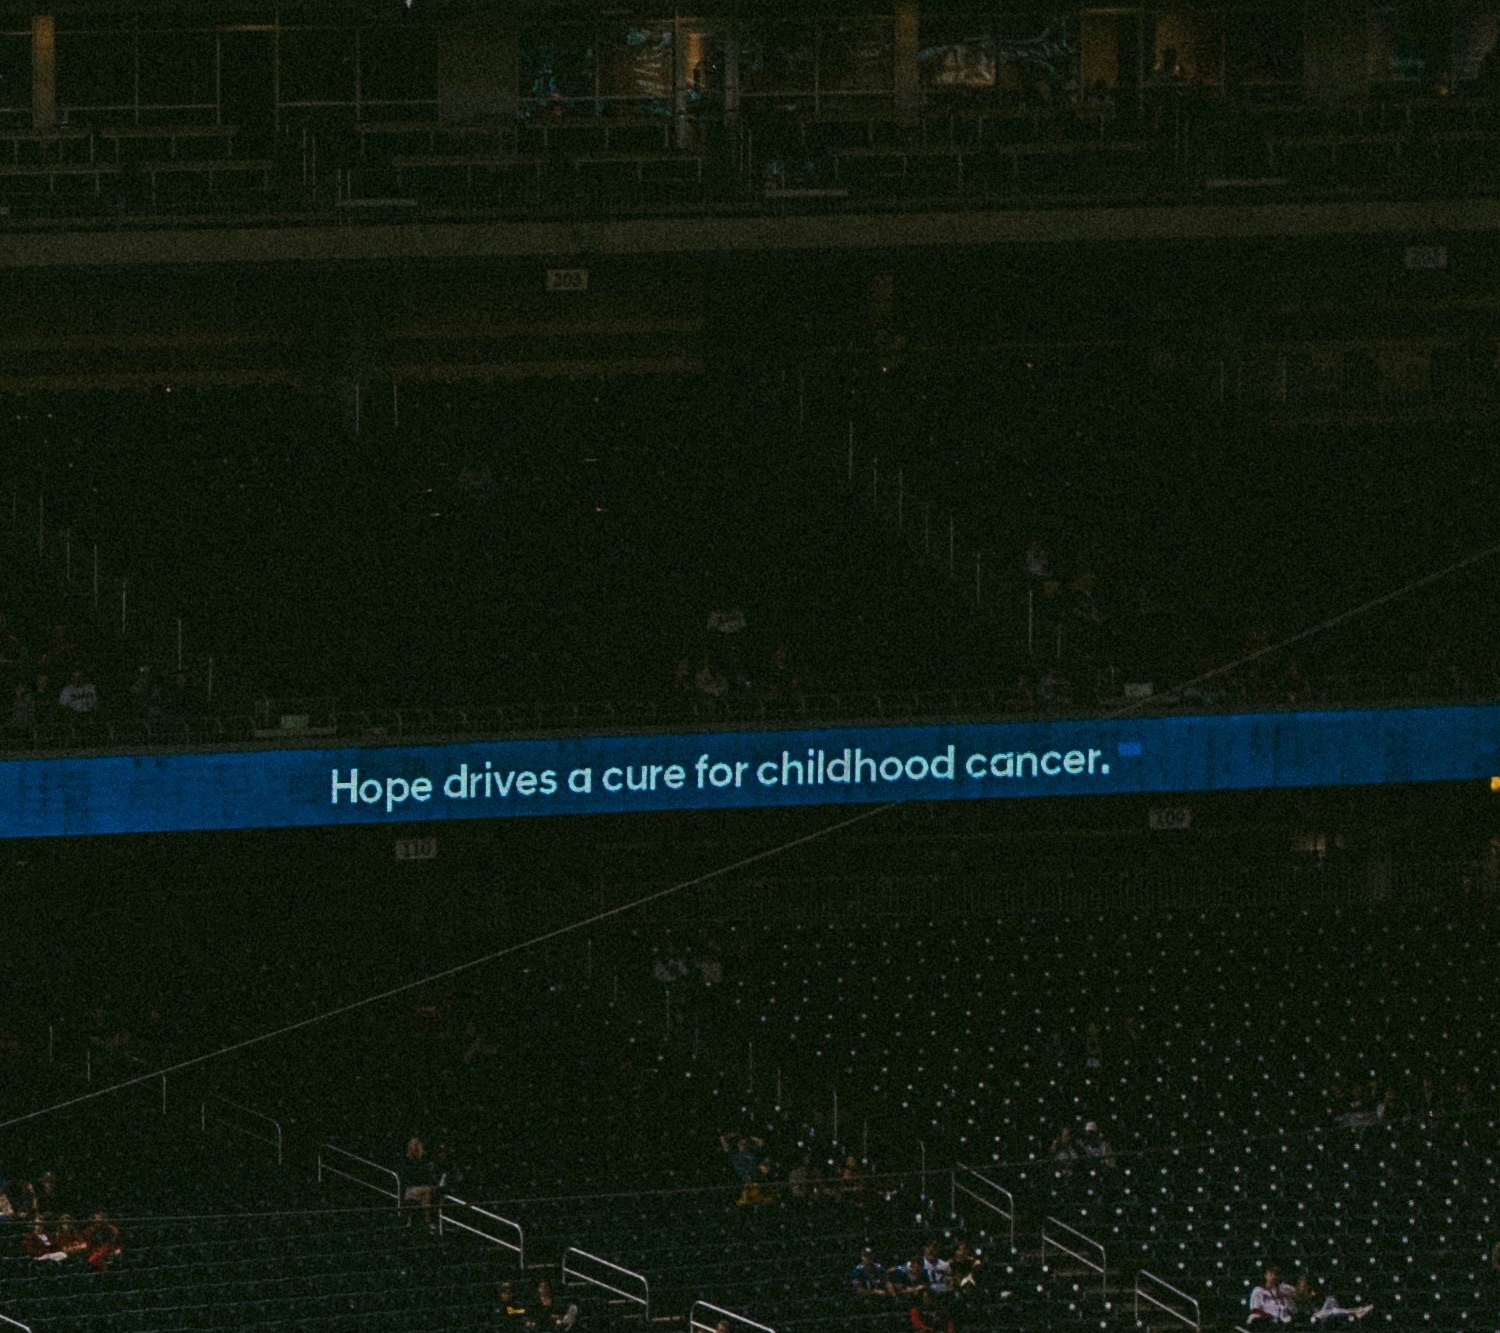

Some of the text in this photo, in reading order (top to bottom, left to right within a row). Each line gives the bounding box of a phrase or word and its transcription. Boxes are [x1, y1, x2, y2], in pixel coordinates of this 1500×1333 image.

[331, 745, 1110, 811] Hope drives a cure for childhood cancer.
